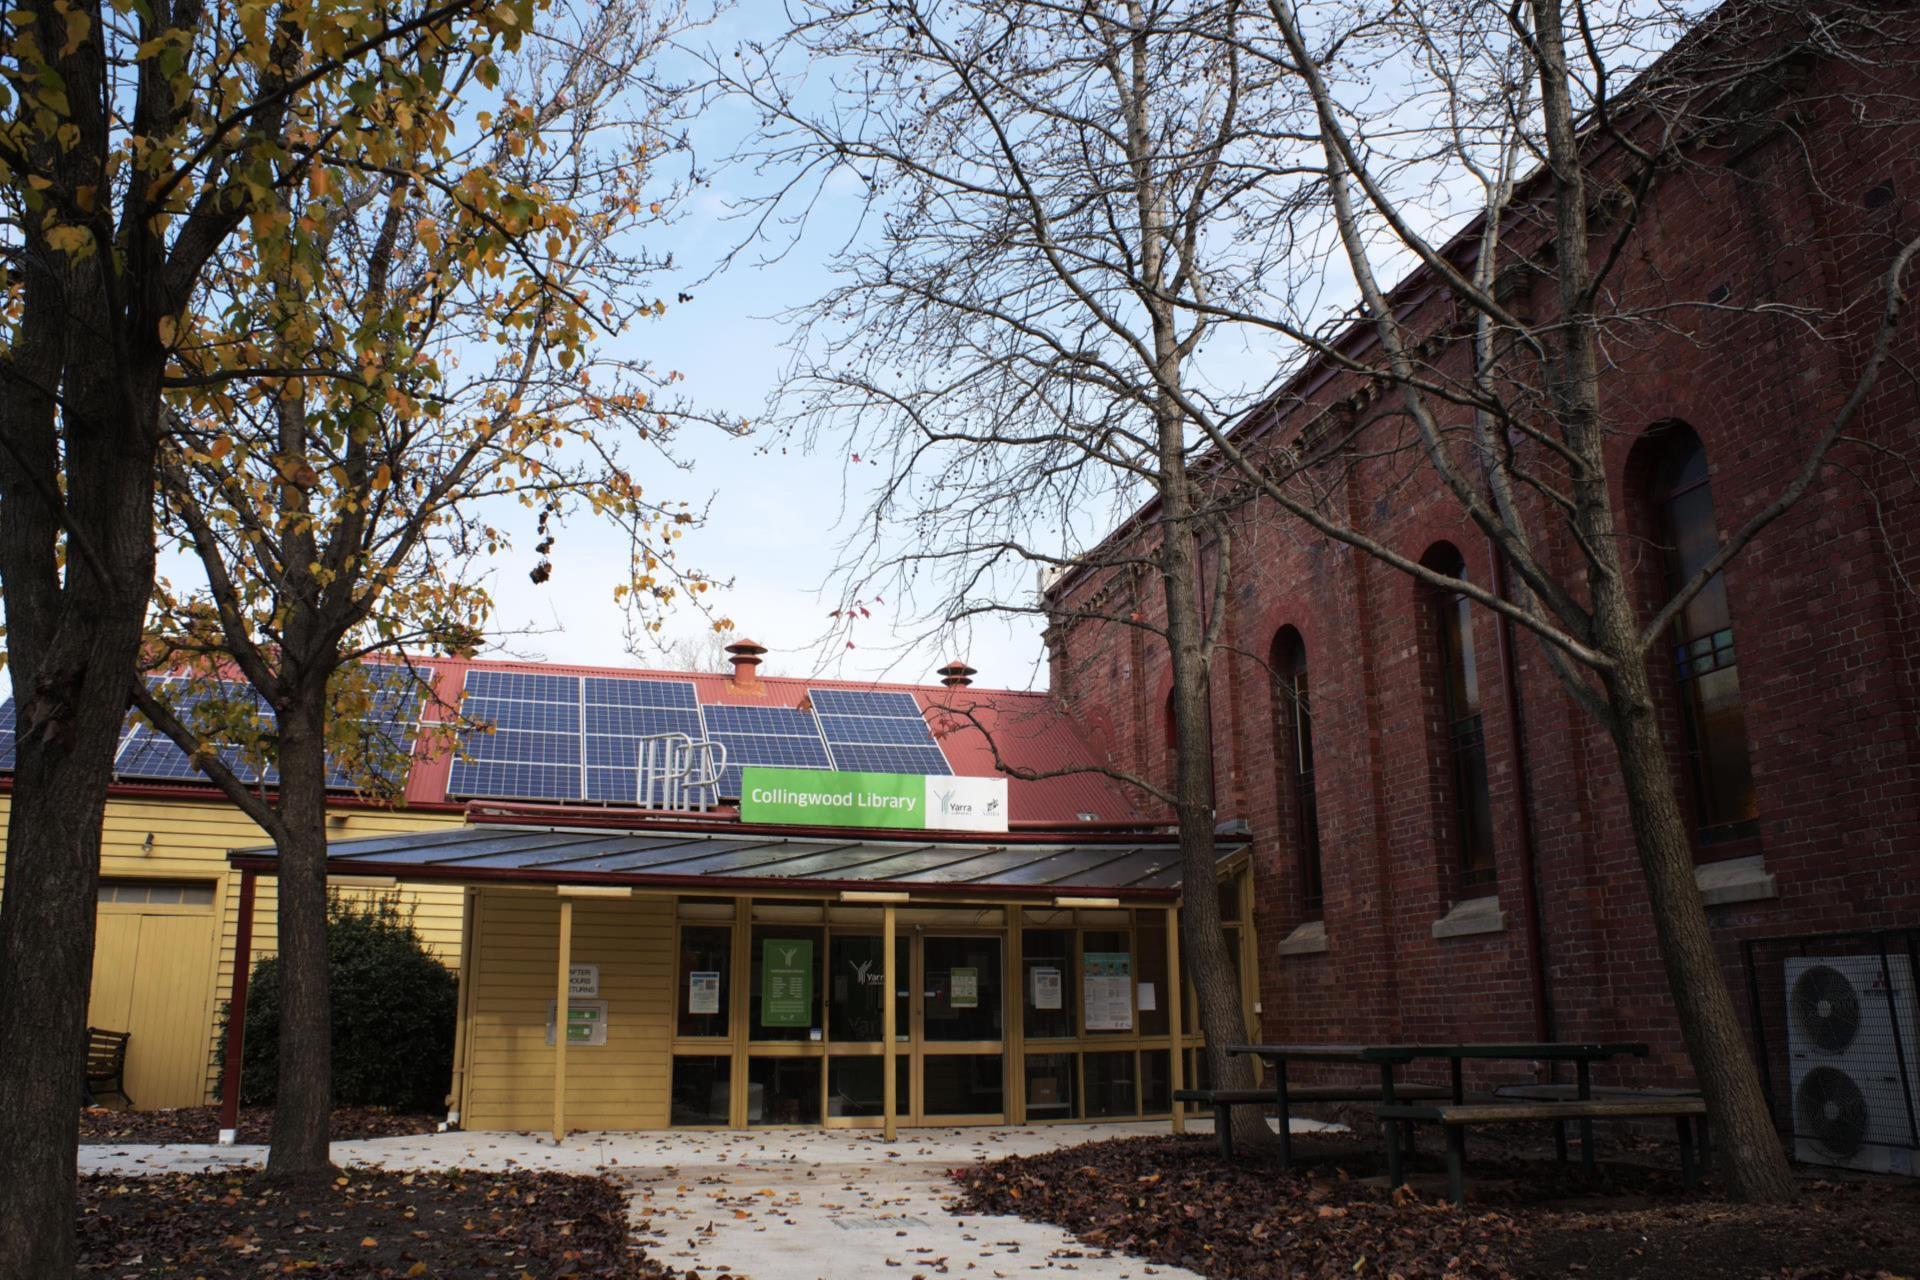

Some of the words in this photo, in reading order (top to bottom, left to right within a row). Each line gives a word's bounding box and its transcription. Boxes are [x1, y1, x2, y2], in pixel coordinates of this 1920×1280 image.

[751, 788, 853, 807] Collingwood
[857, 792, 916, 811] Library
[950, 803, 972, 812] Yarra
[866, 973, 885, 981] Yarr
